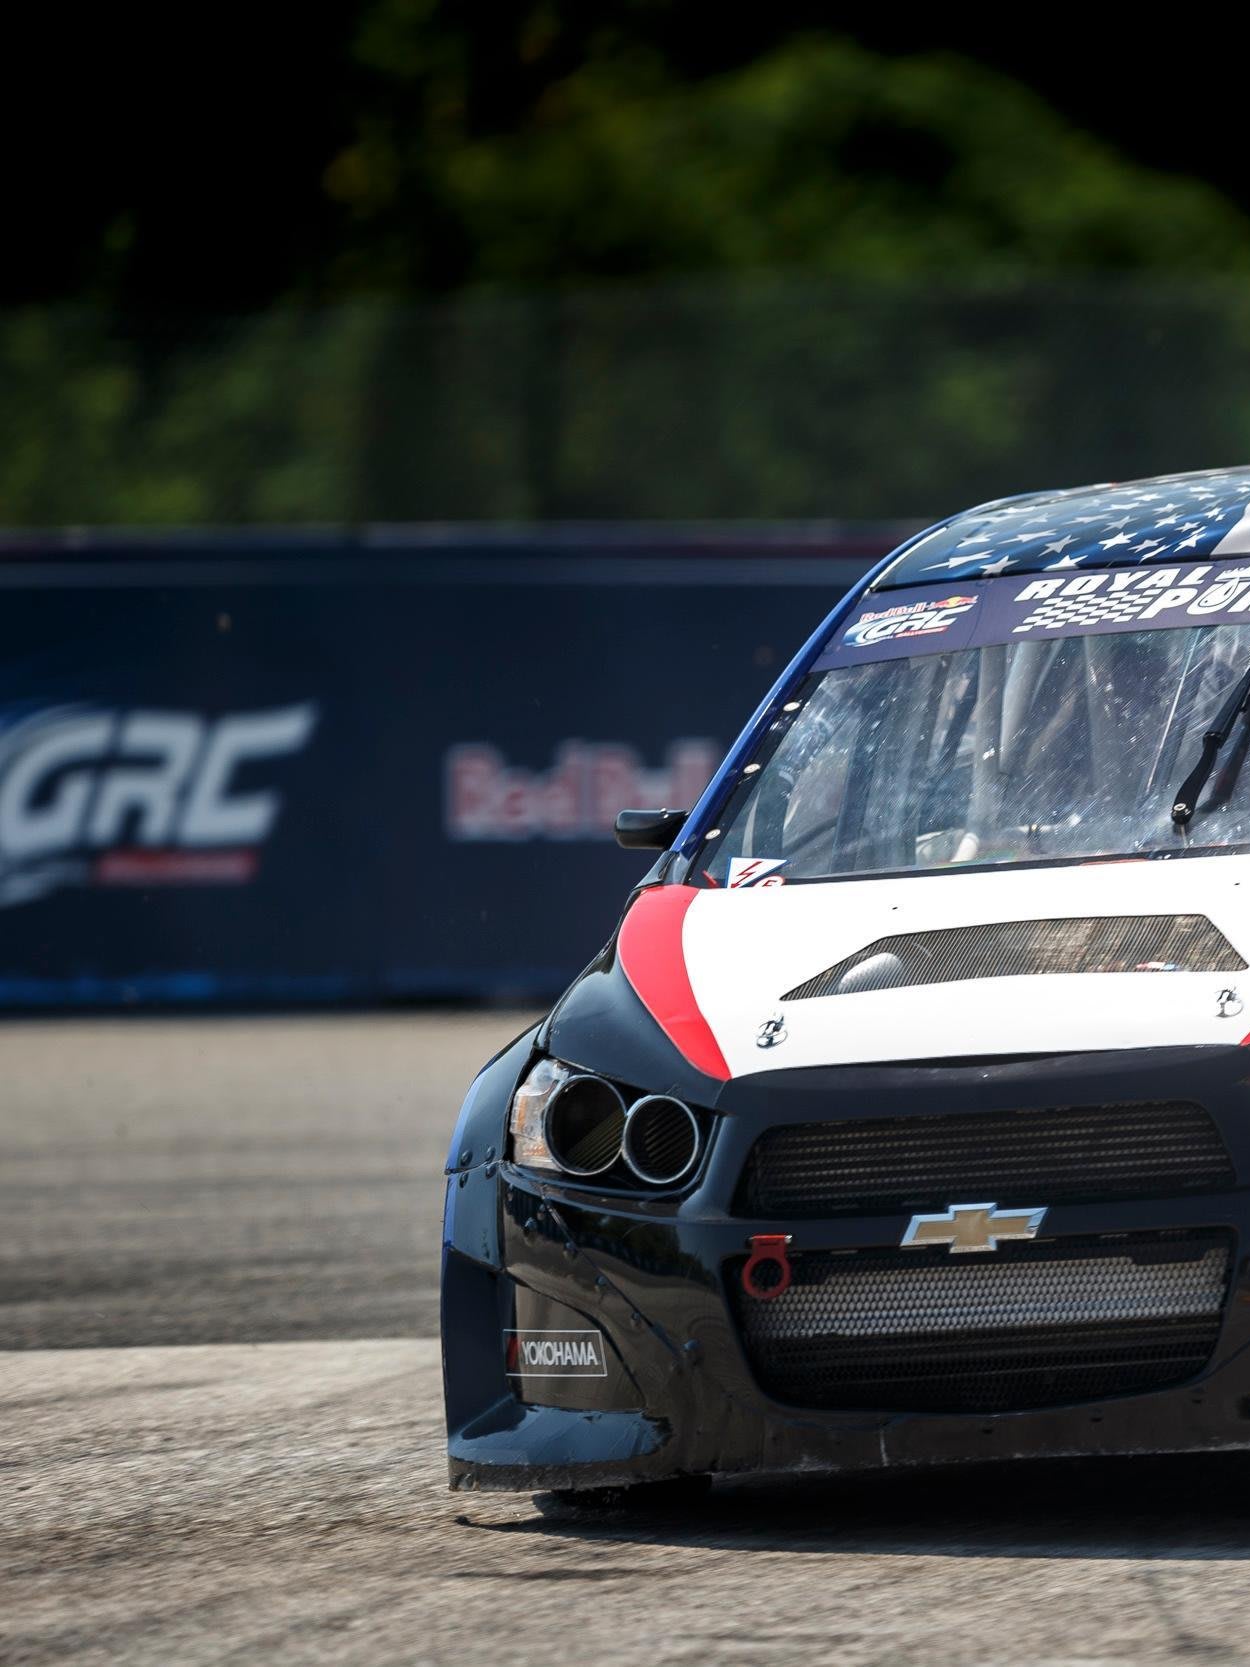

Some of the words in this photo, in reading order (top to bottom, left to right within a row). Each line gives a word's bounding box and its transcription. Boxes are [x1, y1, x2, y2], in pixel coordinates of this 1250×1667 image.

[1014, 566, 1214, 602] ROYAL
[860, 604, 974, 642] GRC
[0, 700, 318, 858] GRC
[521, 1341, 600, 1366] YOKOHAMA
